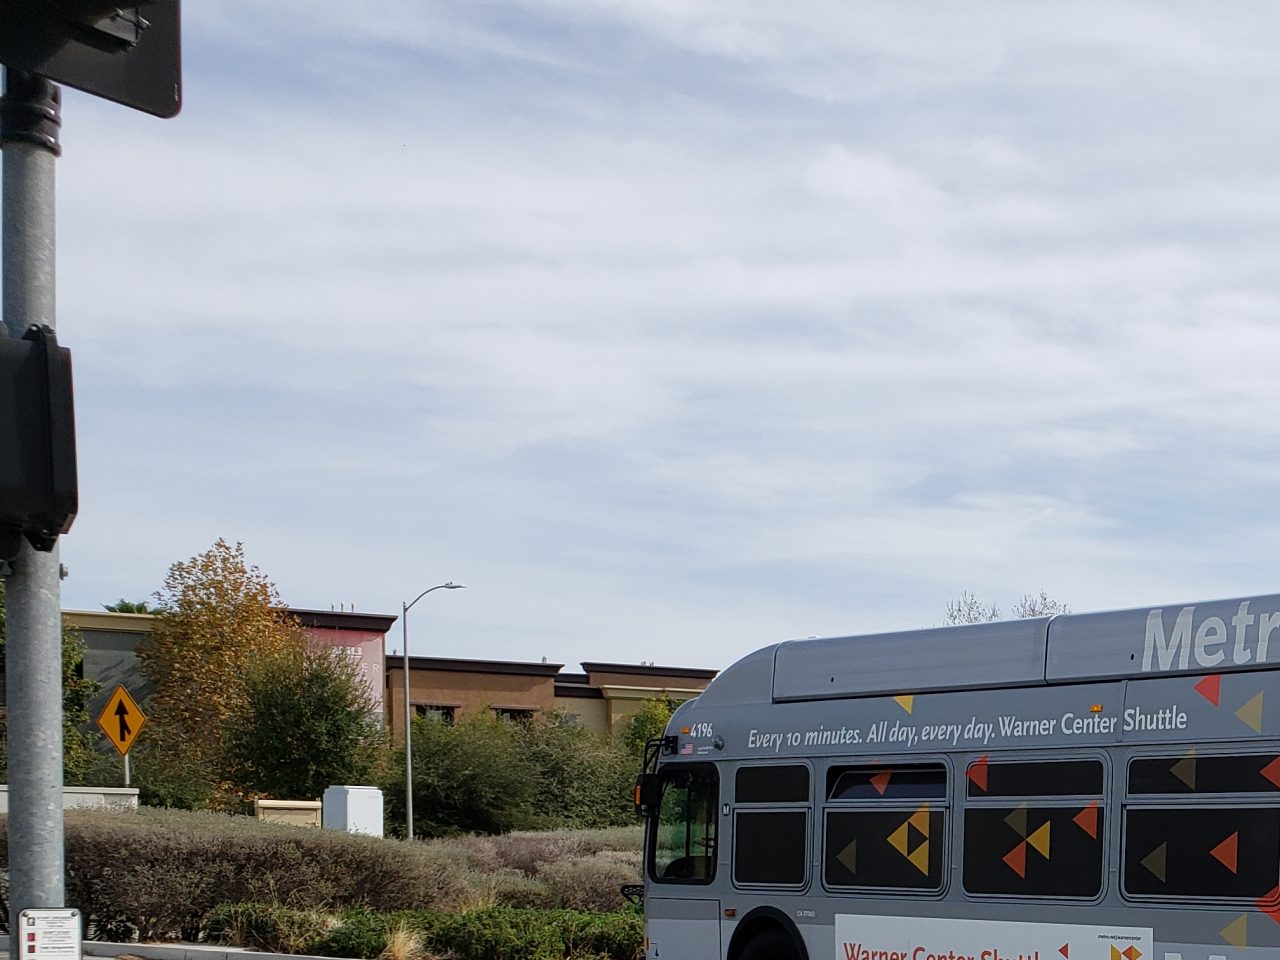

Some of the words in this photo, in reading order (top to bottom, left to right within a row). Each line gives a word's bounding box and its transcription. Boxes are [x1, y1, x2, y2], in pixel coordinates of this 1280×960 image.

[690, 722, 713, 738] 4196
[748, 729, 783, 752] Every
[786, 732, 800, 747] 10
[804, 725, 863, 746] minutes.
[866, 720, 886, 743] All
[889, 720, 918, 747] day,
[921, 723, 961, 746] every
[964, 716, 995, 745] day.
[998, 716, 1057, 738] Warner
[1061, 712, 1118, 735] Center
[1122, 705, 1188, 731] Shuttle
